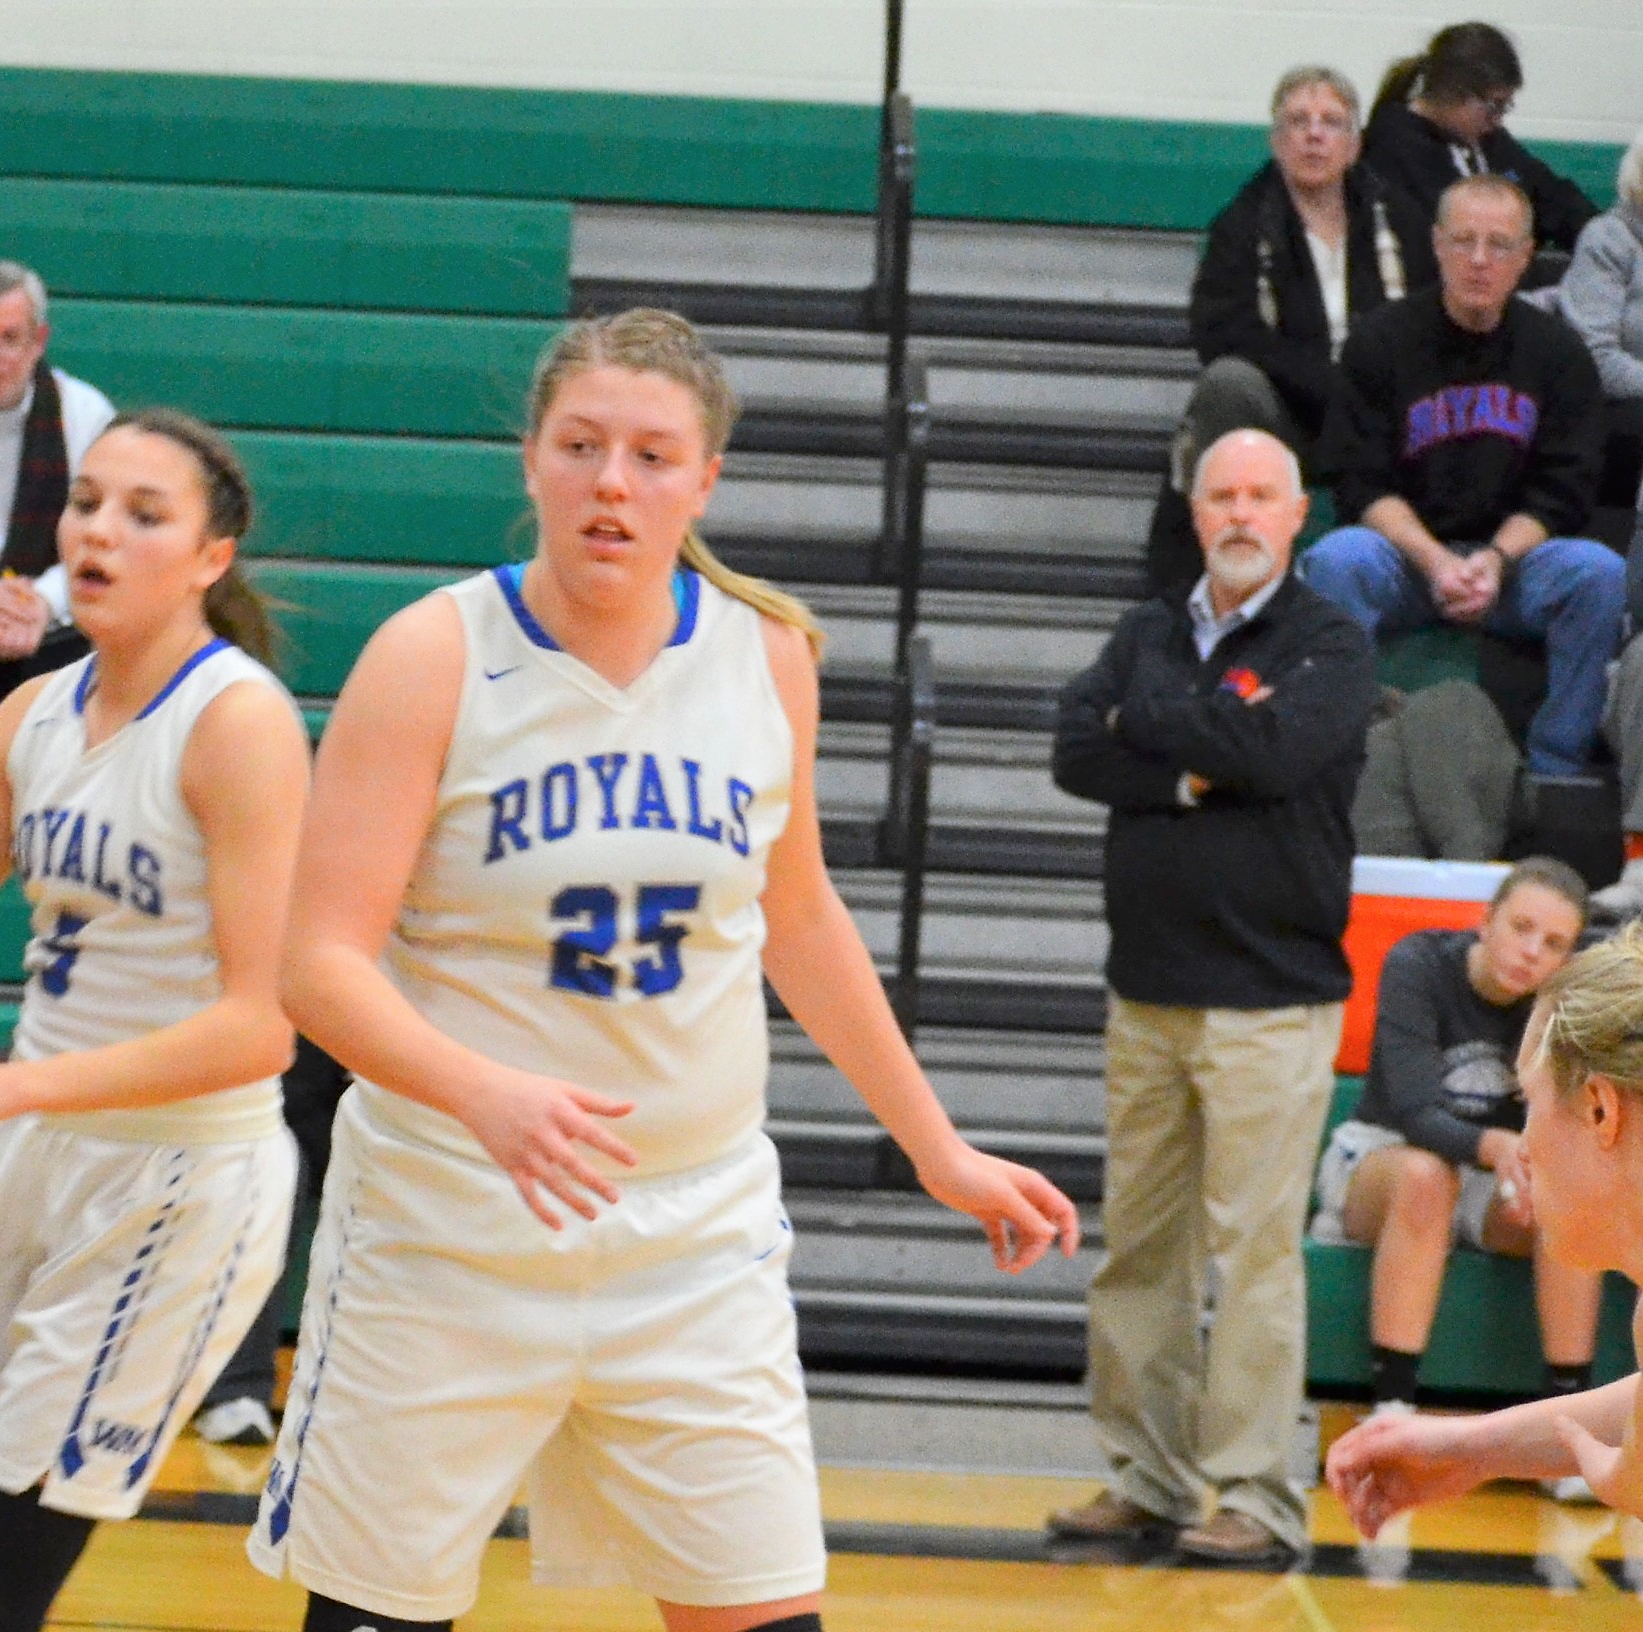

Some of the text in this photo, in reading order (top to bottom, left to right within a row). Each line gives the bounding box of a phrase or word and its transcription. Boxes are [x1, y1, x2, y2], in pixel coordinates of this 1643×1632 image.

[13, 808, 162, 918] OYALS
[484, 752, 755, 863] ROYALS
[549, 881, 702, 996] 25
